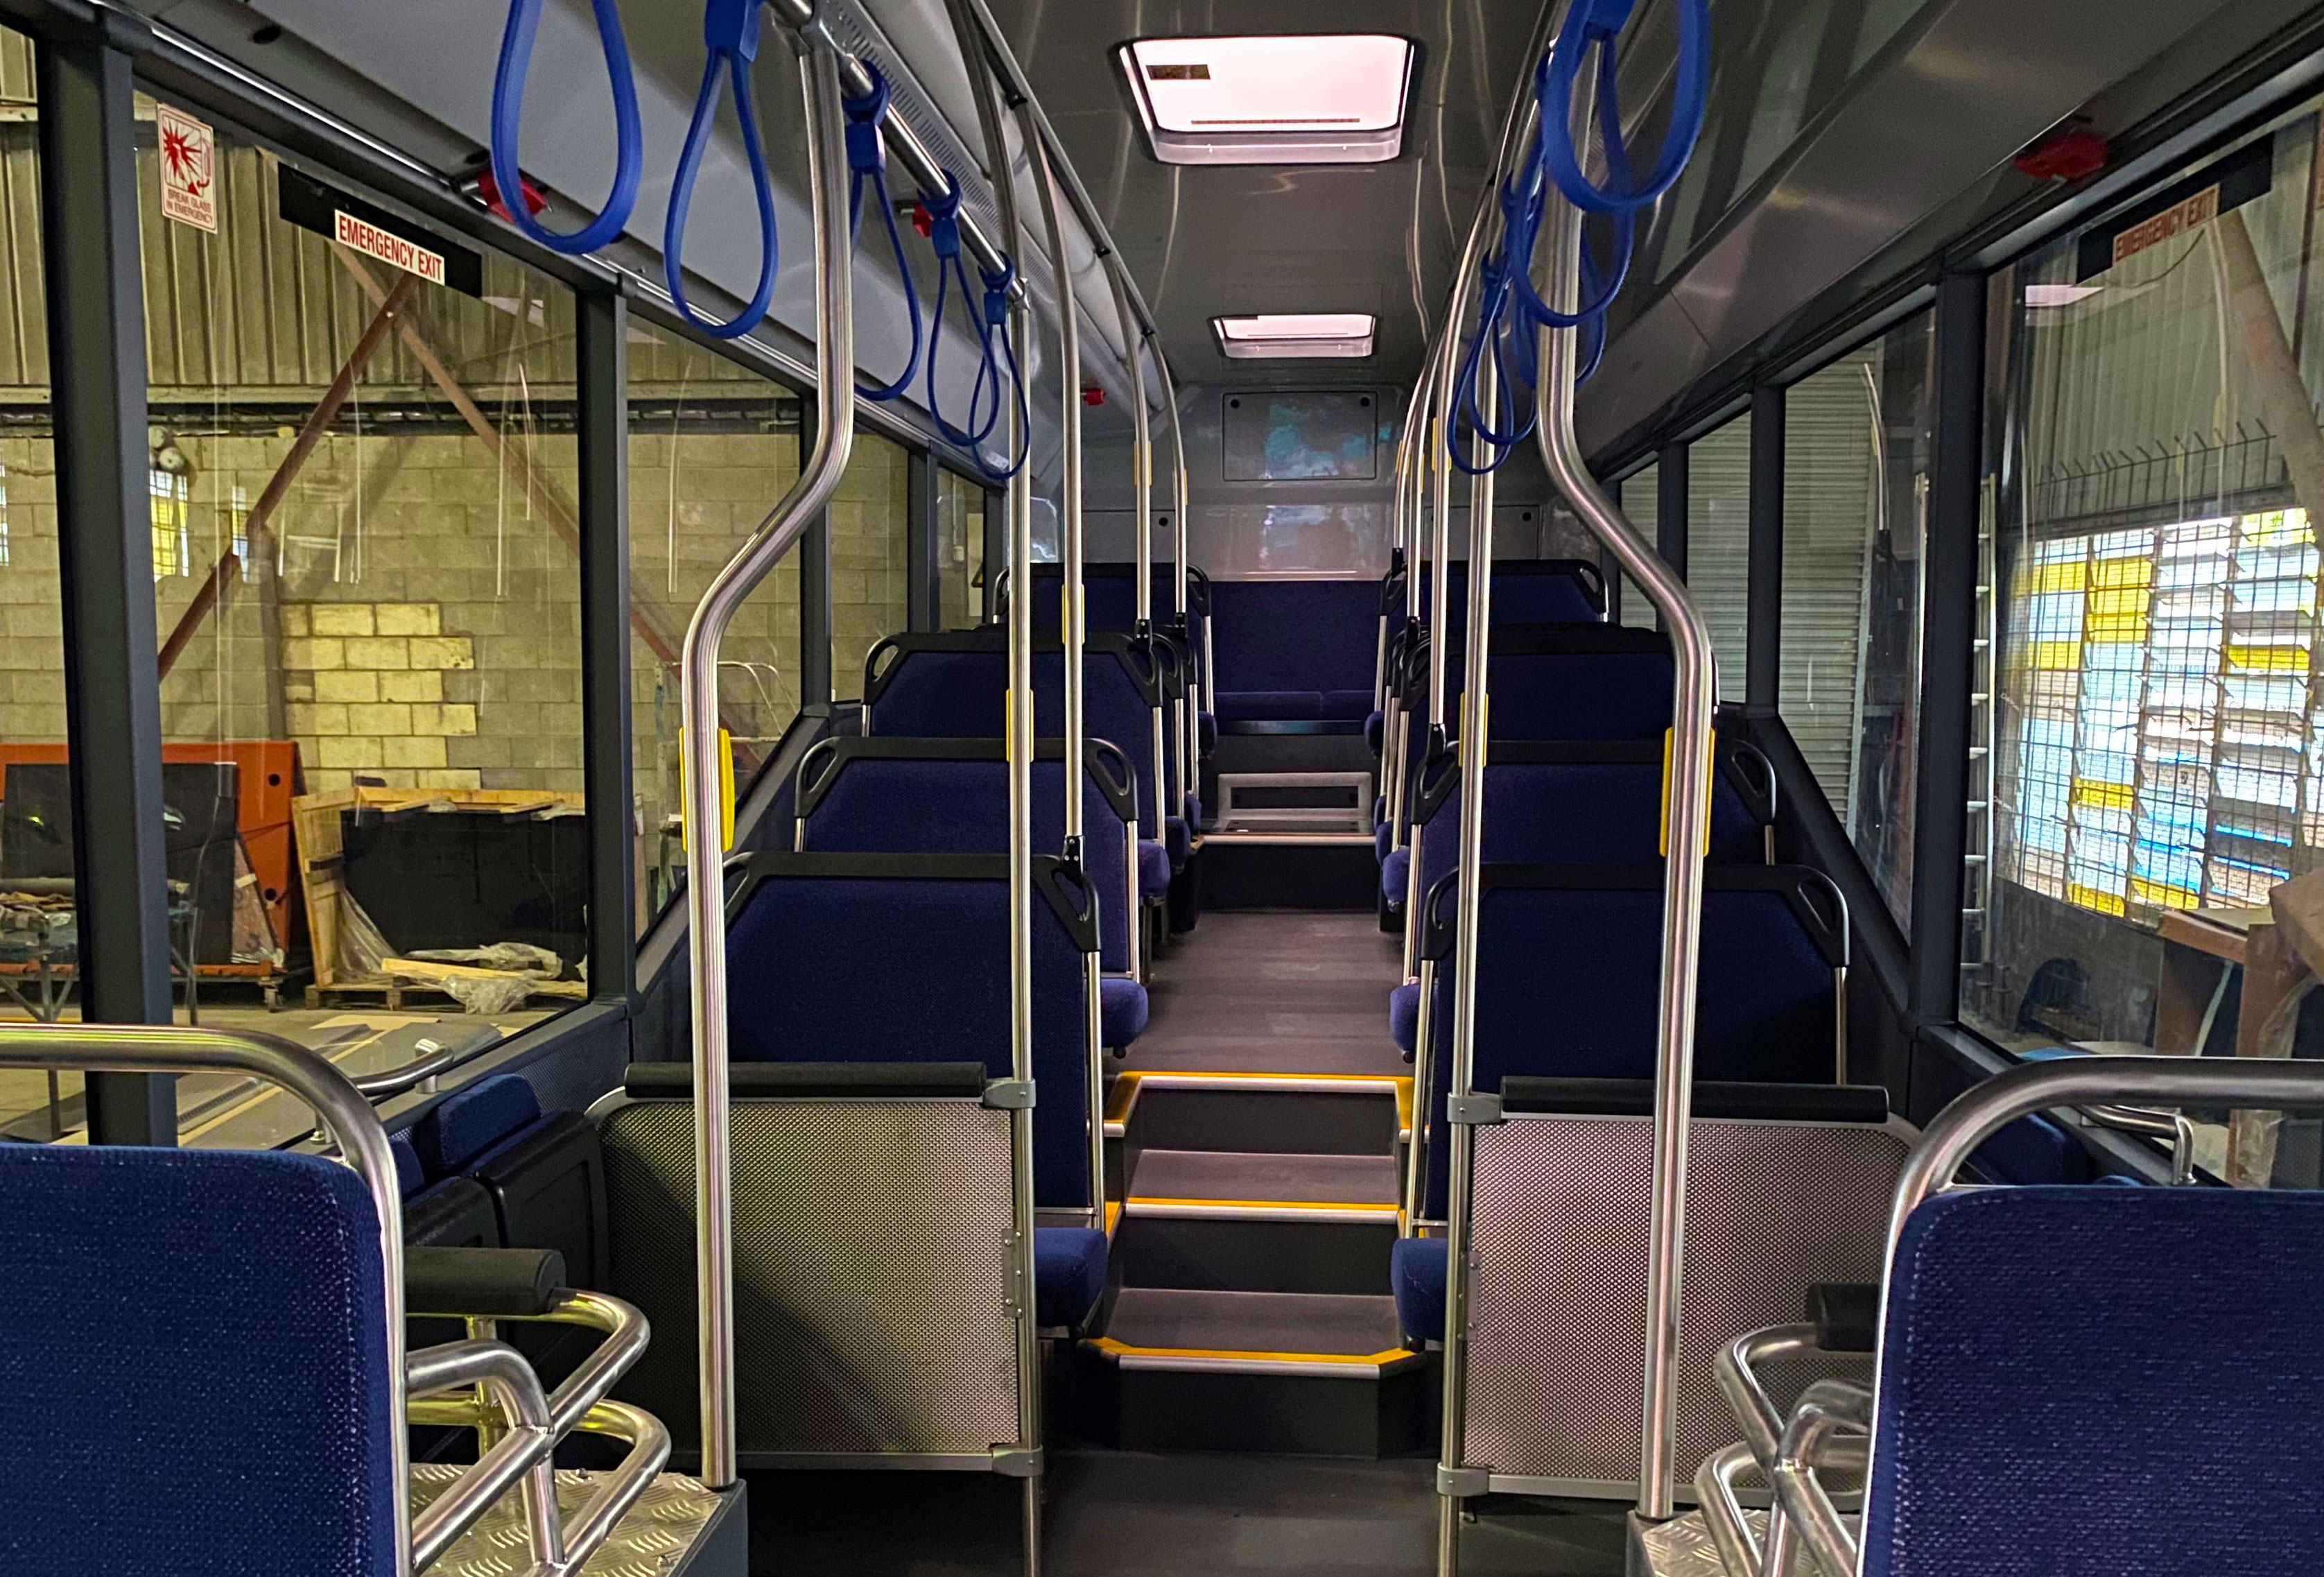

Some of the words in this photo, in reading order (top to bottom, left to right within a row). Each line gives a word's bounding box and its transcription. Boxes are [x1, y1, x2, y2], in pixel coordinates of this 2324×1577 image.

[166, 199, 173, 210] IN
[174, 202, 213, 224] EMERGENCY
[168, 189, 189, 204] BREAK
[191, 197, 211, 213] GLASS
[339, 214, 415, 269] EMERGENCY
[418, 250, 442, 281] EXIT
[2115, 204, 2185, 263] EMERGENCY
[2187, 188, 2217, 227] EXIT
